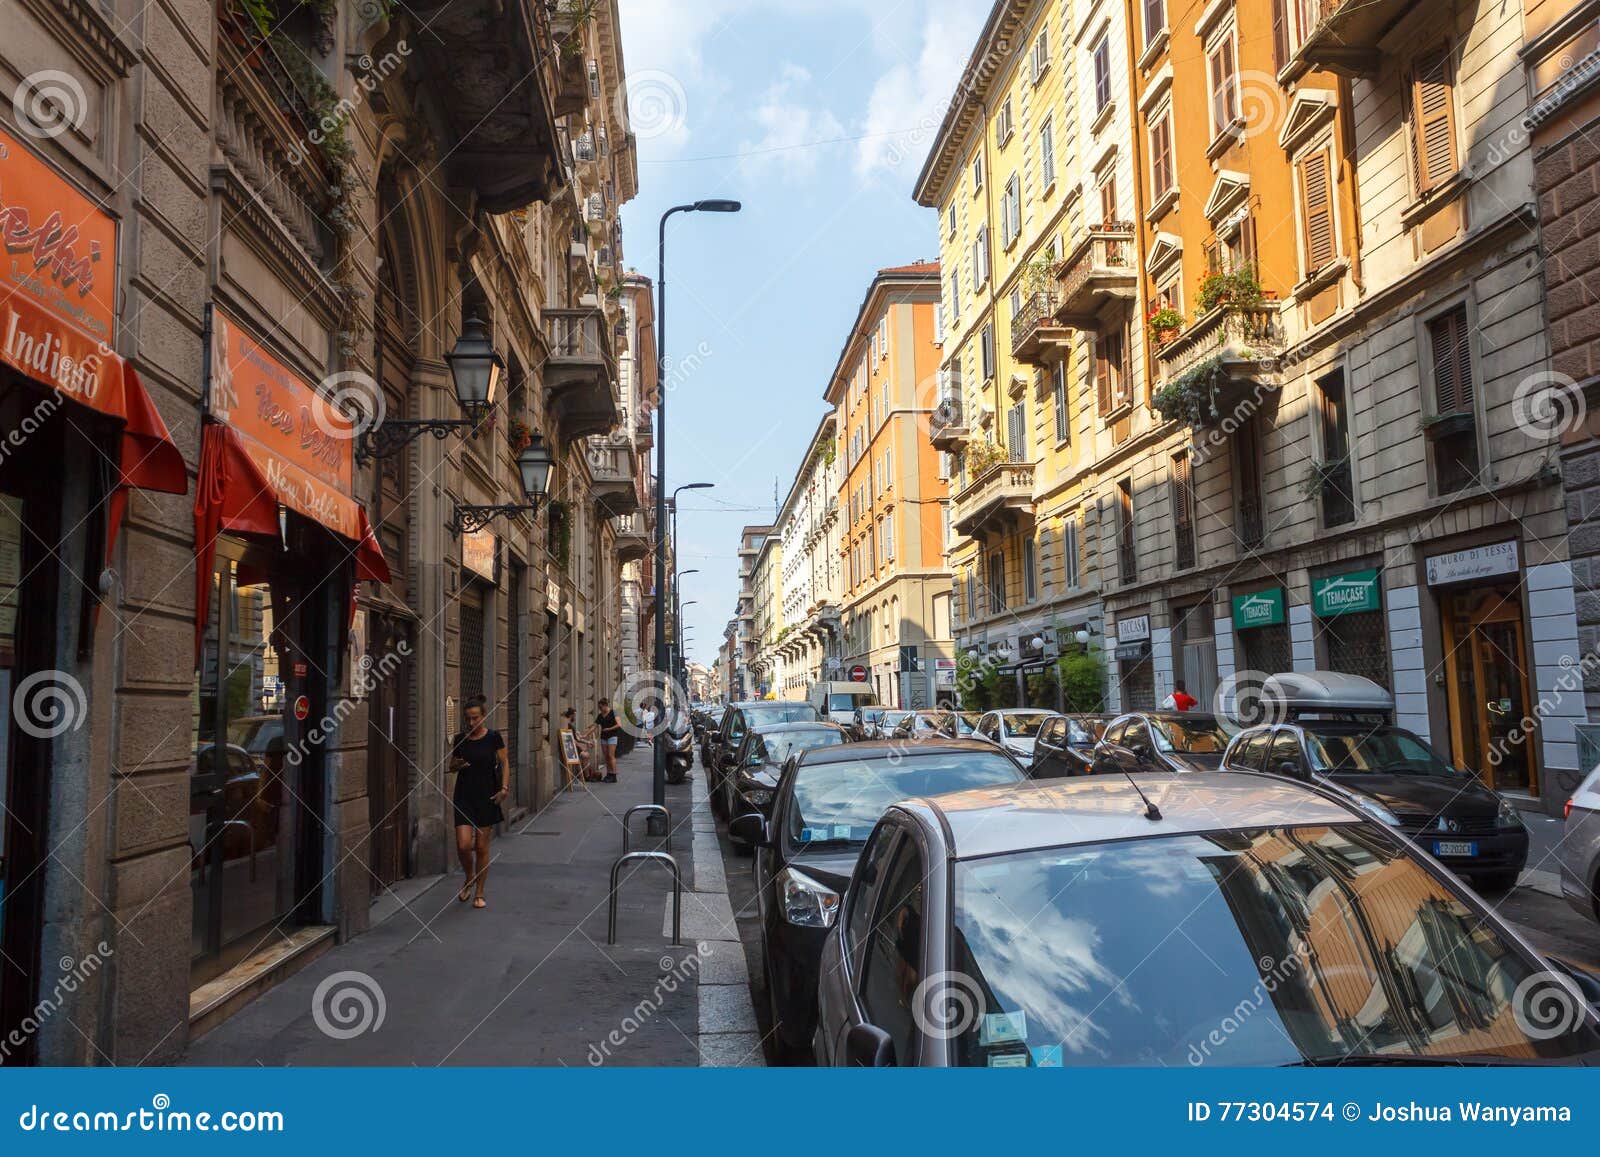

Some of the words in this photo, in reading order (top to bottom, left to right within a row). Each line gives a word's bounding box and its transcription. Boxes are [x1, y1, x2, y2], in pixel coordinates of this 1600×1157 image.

[265, 457, 299, 502] New
[304, 479, 340, 524] Delhi
[1440, 553, 1465, 566] MURO
[1470, 550, 1480, 560] DI
[1485, 543, 1514, 558] TESSA
[1326, 585, 1365, 606] TEMACASE
[1246, 603, 1270, 618] TEMACASE
